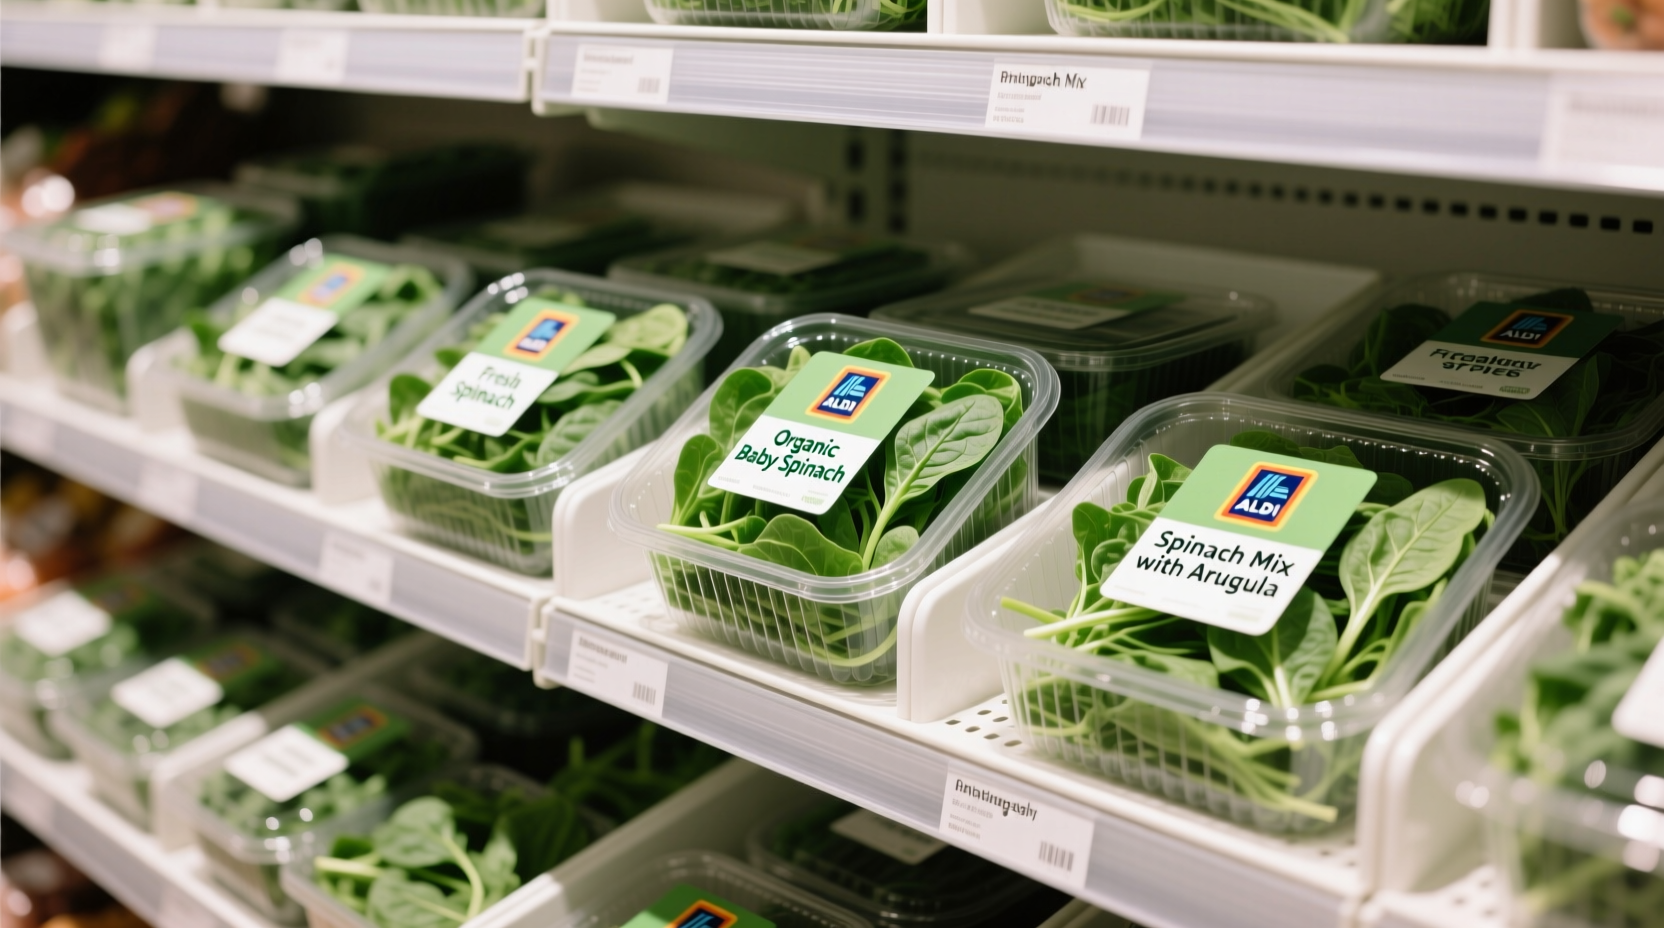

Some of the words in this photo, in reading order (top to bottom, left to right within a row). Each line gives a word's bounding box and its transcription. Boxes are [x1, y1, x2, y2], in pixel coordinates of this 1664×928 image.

[478, 366, 522, 390] Fresh
[449, 381, 515, 410] Spinach
[822, 396, 857, 412] ALDI
[774, 429, 841, 458] Organic
[734, 444, 779, 472] Baby
[777, 454, 846, 484] Spinach
[1234, 498, 1281, 518] ALDI
[1154, 530, 1245, 565] Spinach
[1249, 550, 1296, 577] Mix
[1136, 554, 1184, 577] with
[1187, 562, 1279, 597] Arugula
